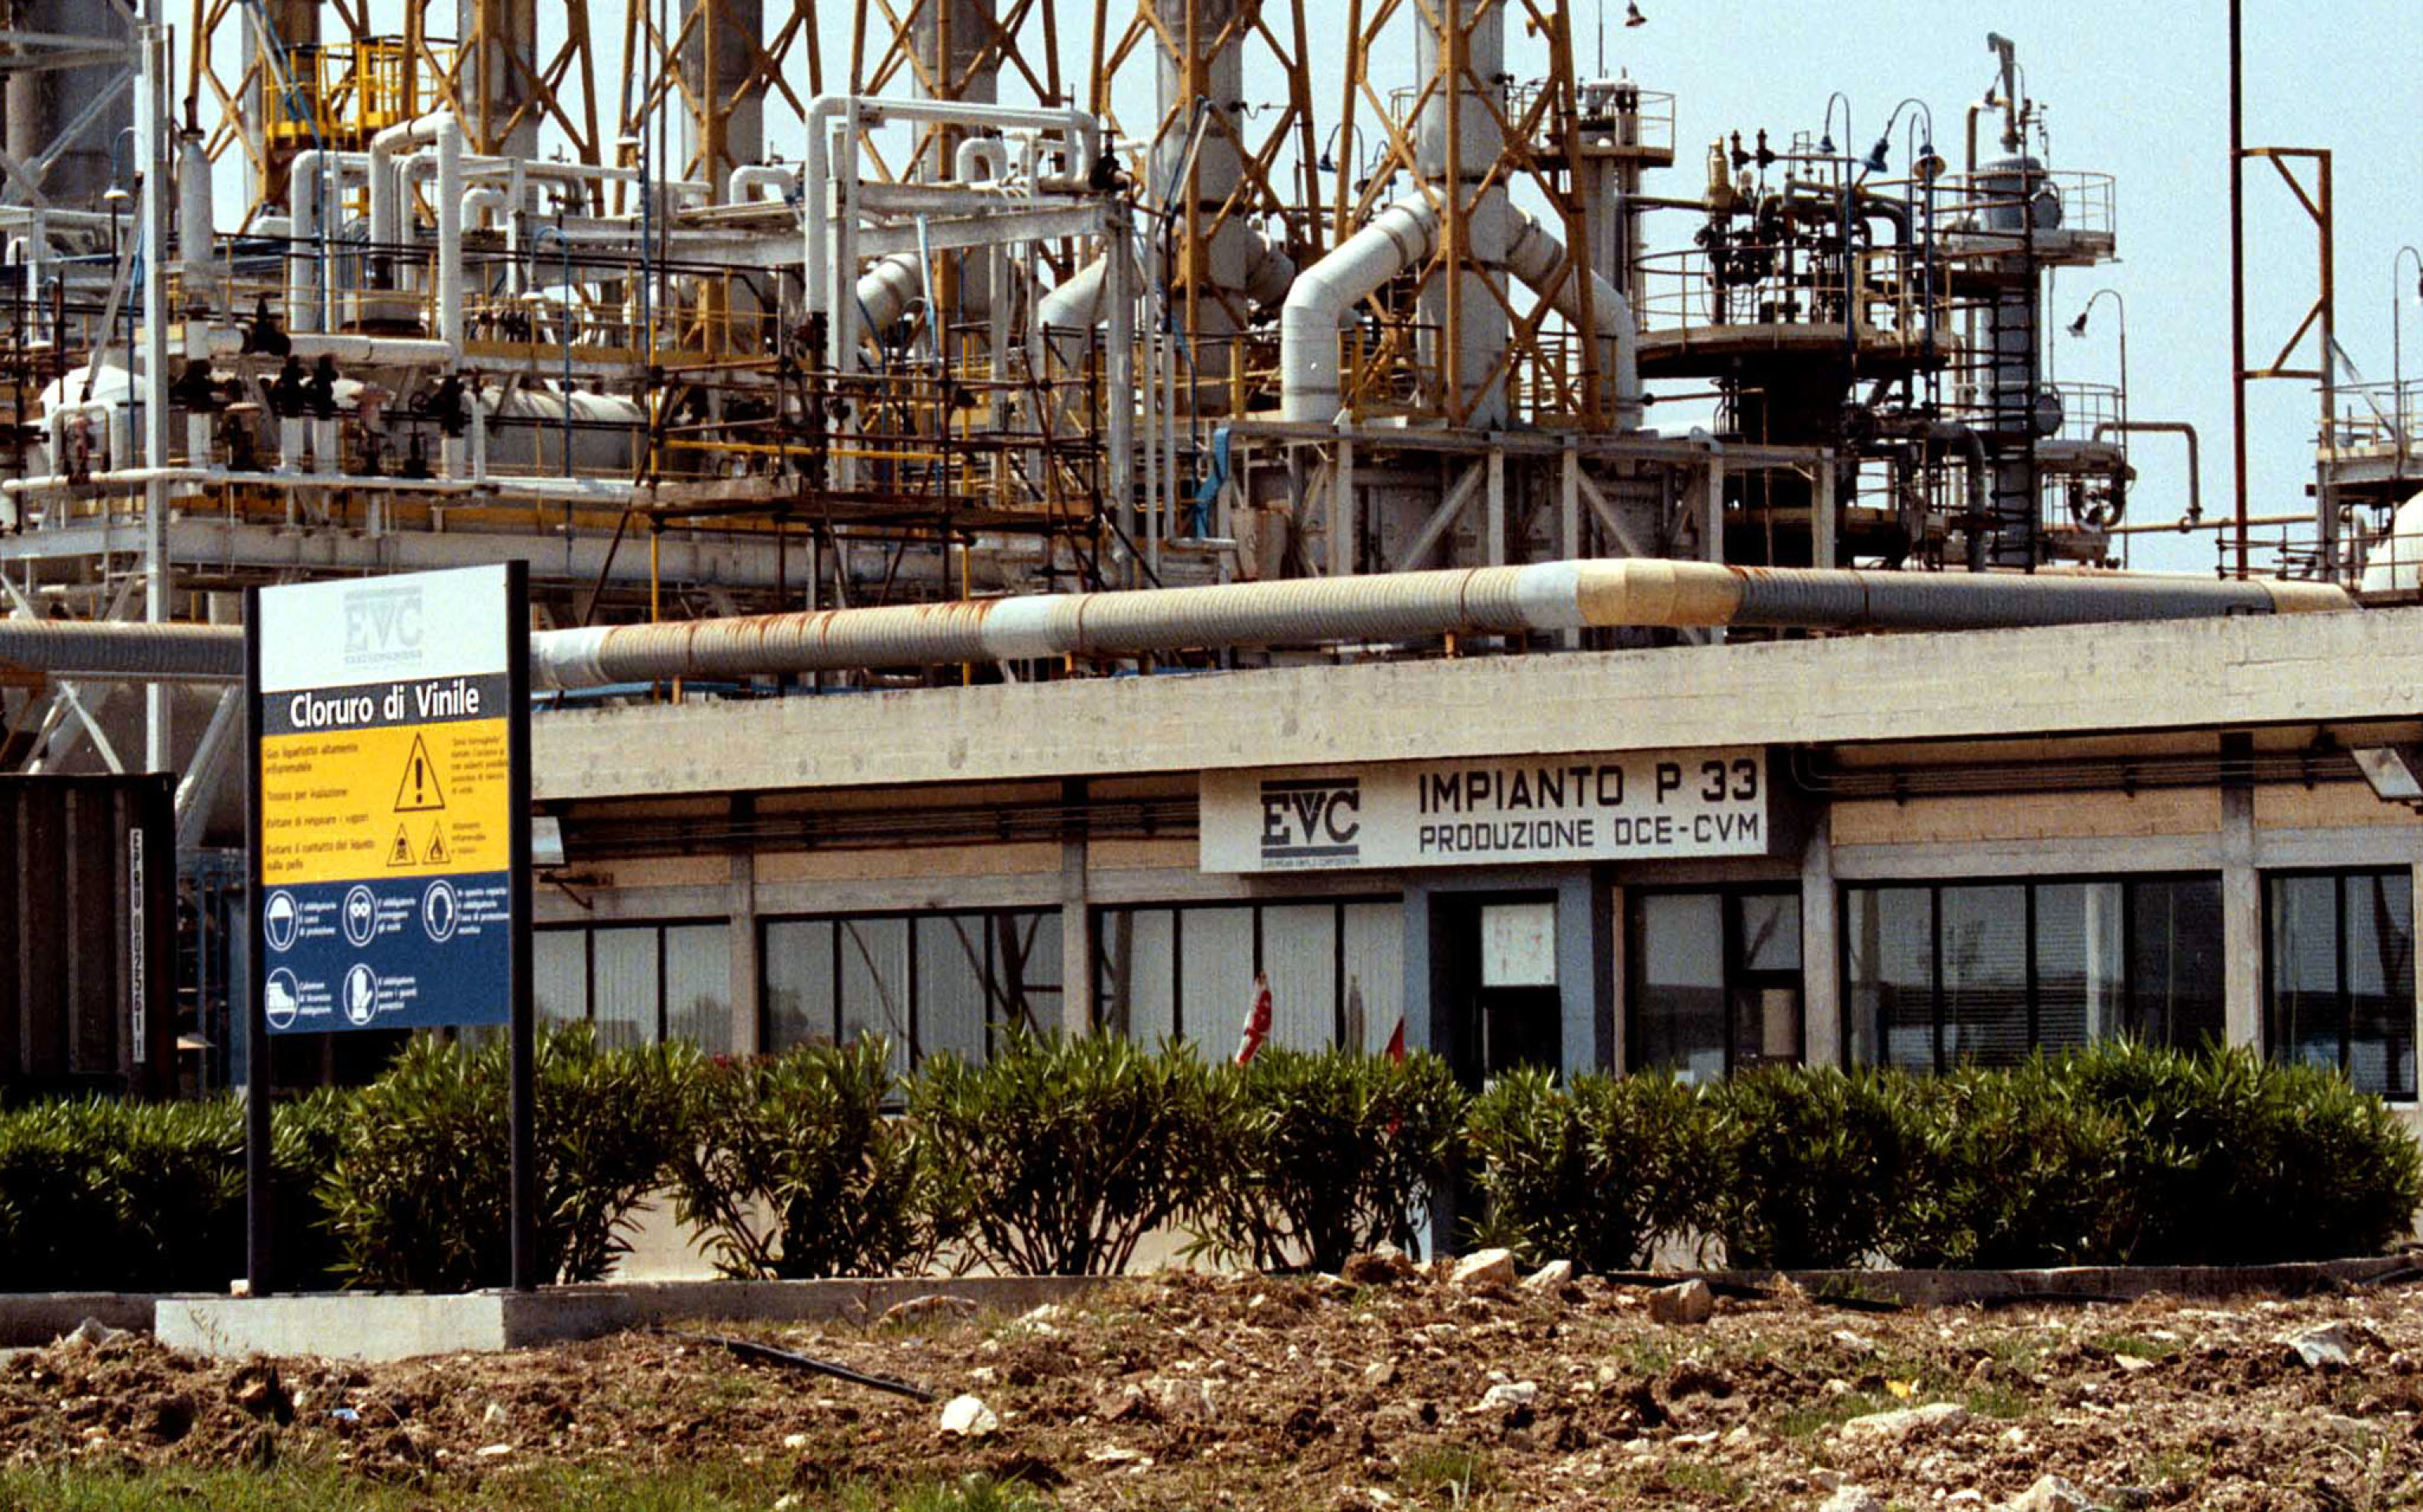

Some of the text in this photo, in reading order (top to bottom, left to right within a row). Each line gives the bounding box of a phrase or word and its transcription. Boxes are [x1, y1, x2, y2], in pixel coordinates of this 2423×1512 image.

[345, 597, 424, 652] EVC
[289, 678, 480, 727] Cloruro di Vinile
[1420, 759, 1757, 813] IMPIANTO P 33
[1260, 790, 1361, 845] EVC
[1420, 813, 1758, 852] PRODUZIONE DCE-CVM
